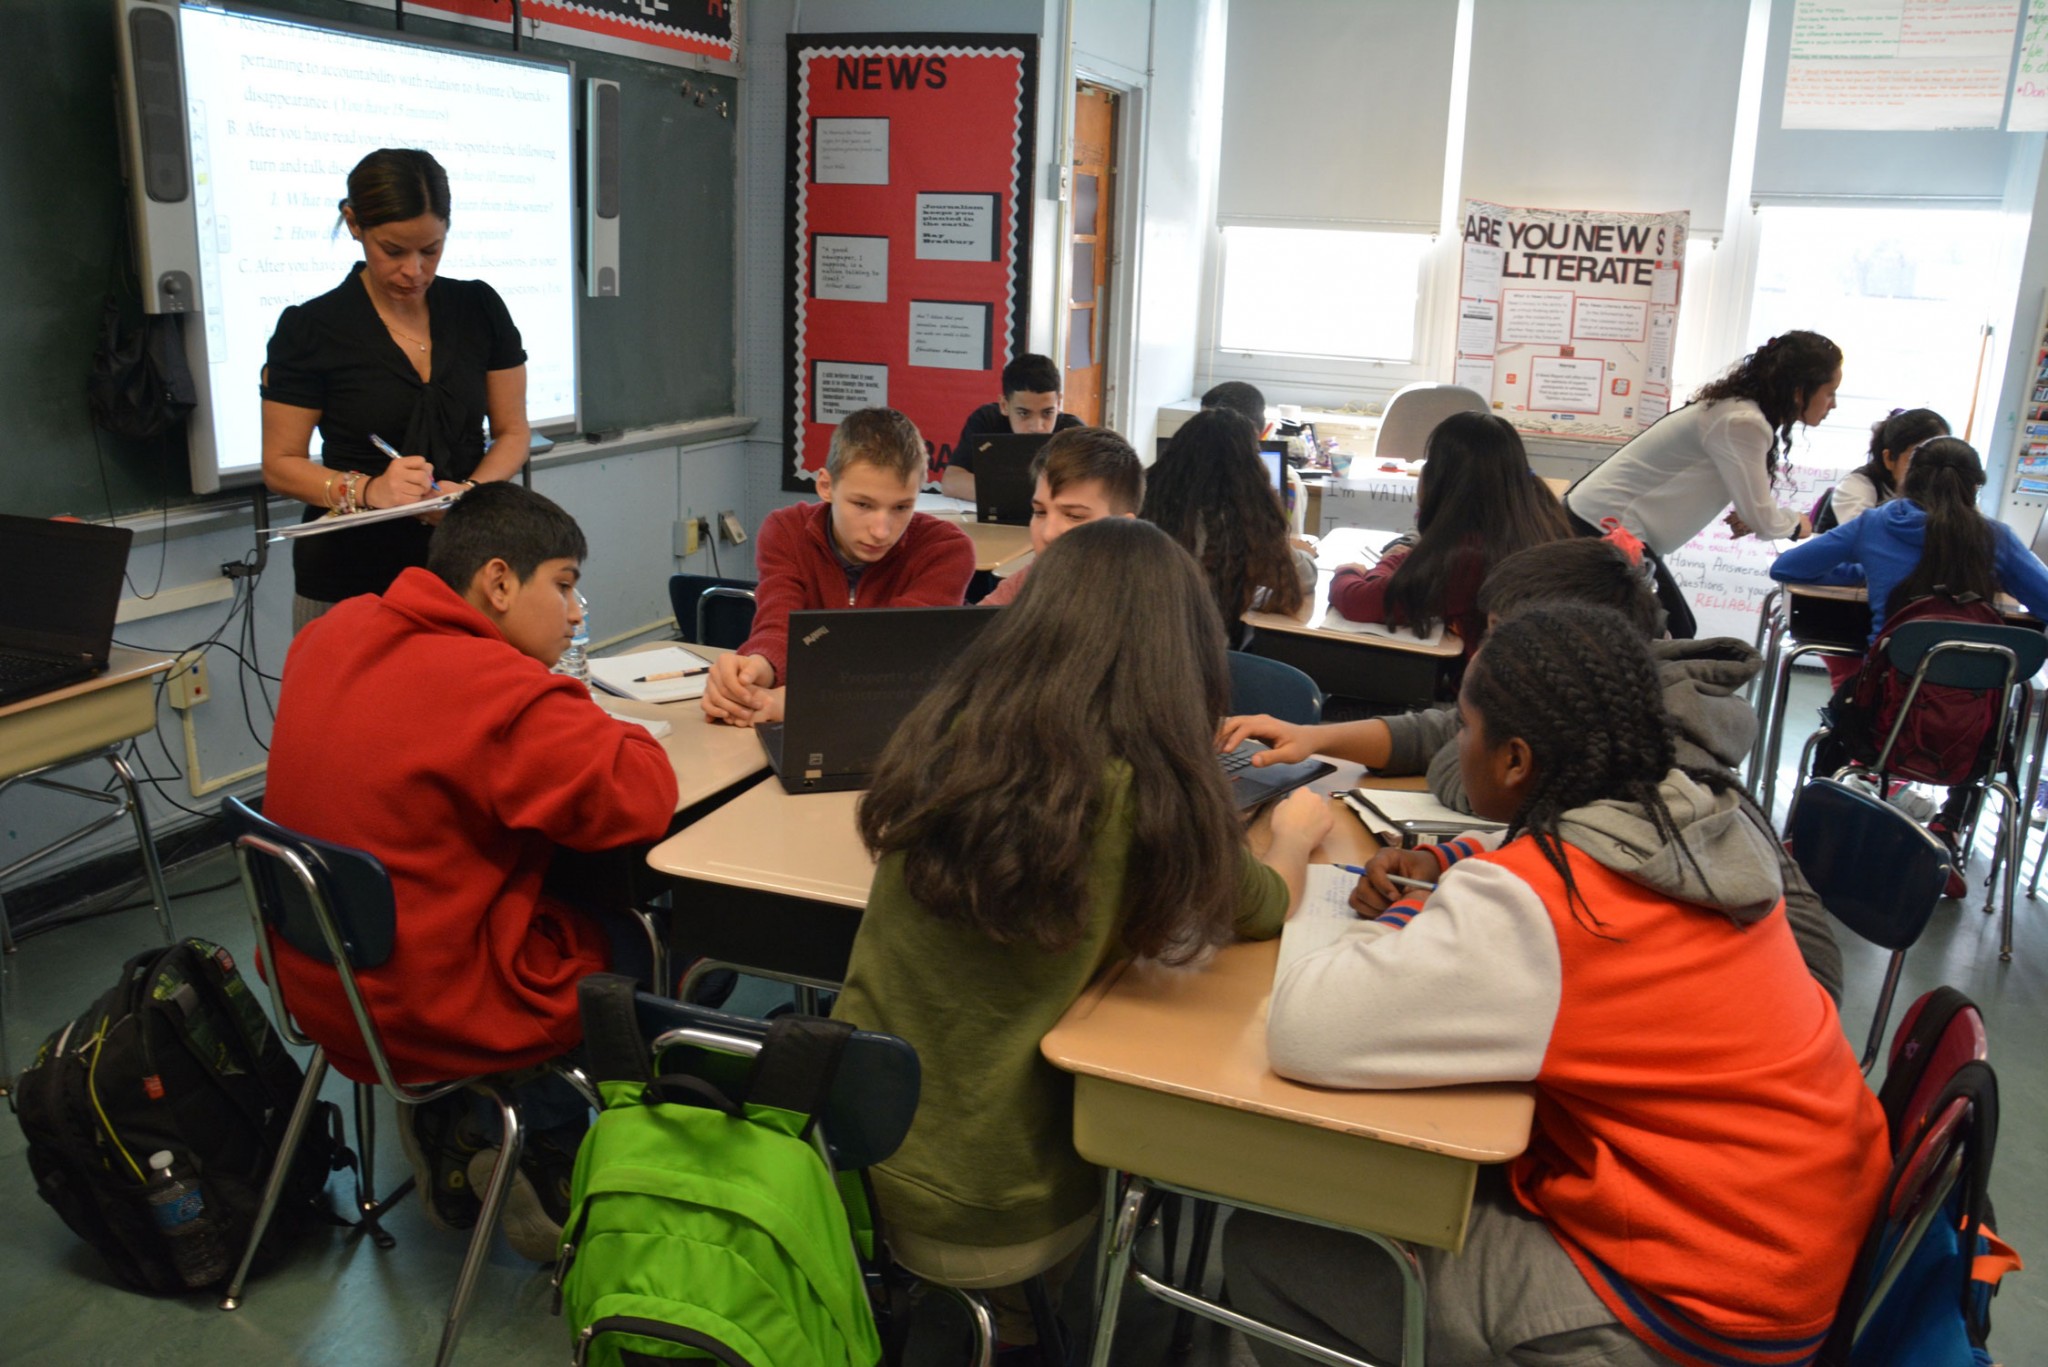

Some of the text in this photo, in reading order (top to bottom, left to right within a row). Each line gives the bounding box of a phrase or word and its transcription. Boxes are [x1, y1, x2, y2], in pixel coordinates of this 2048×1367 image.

[240, 54, 303, 76] pertaining
[306, 62, 319, 74] to
[321, 65, 396, 87] accountability
[399, 72, 421, 88] with
[424, 74, 460, 92] relation
[462, 81, 473, 94] to
[836, 57, 947, 90] NEWS
[248, 120, 276, 138] After
[280, 128, 301, 142] you
[304, 122, 329, 142] have
[332, 128, 356, 144] read
[248, 159, 277, 173] turn
[280, 157, 301, 173] and
[303, 159, 326, 175] talk
[287, 191, 321, 208] What
[290, 225, 321, 241] How
[1465, 214, 1502, 247] ARE
[1507, 221, 1570, 250] YOU
[256, 256, 285, 273] After
[288, 261, 309, 277] you
[311, 256, 336, 273] have
[1502, 250, 1655, 286] LITERATE
[1369, 482, 1414, 504] VAIN
[1669, 553, 1769, 580] Having Answered
[1735, 586, 1743, 594] is
